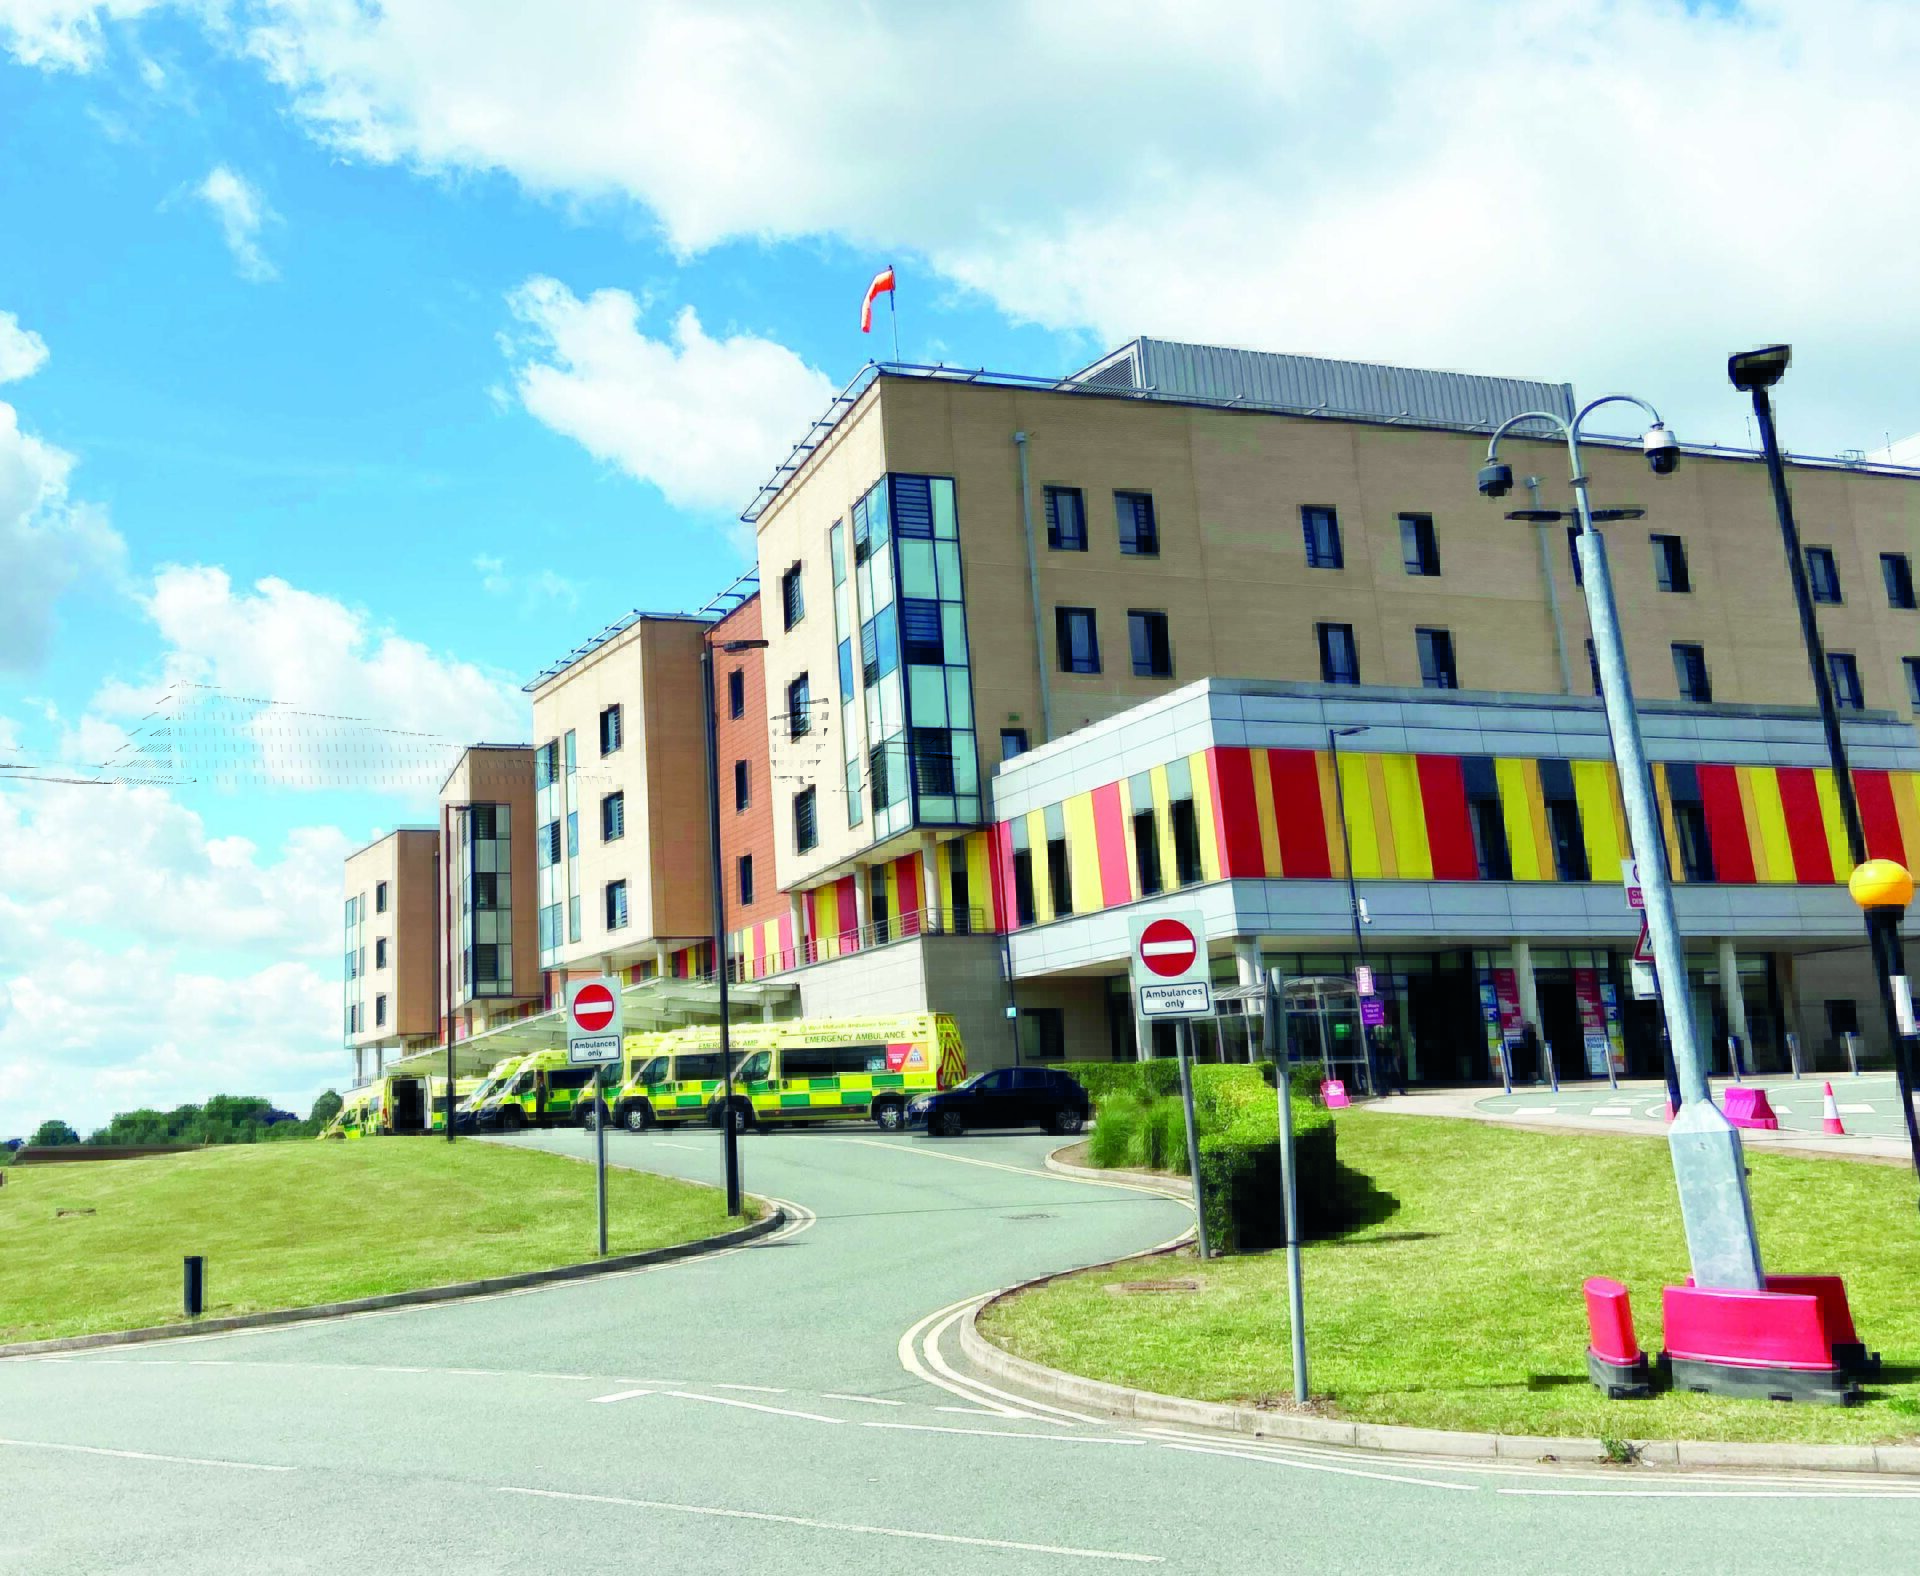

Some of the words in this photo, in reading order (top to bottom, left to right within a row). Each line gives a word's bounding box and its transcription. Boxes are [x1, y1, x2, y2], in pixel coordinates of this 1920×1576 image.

[1145, 988, 1203, 999] Ambulances
[1165, 999, 1185, 1009] only
[804, 1034, 853, 1044] EMERGENCY
[855, 1031, 906, 1042] AMBULANCE
[574, 1041, 616, 1049] Ambulances
